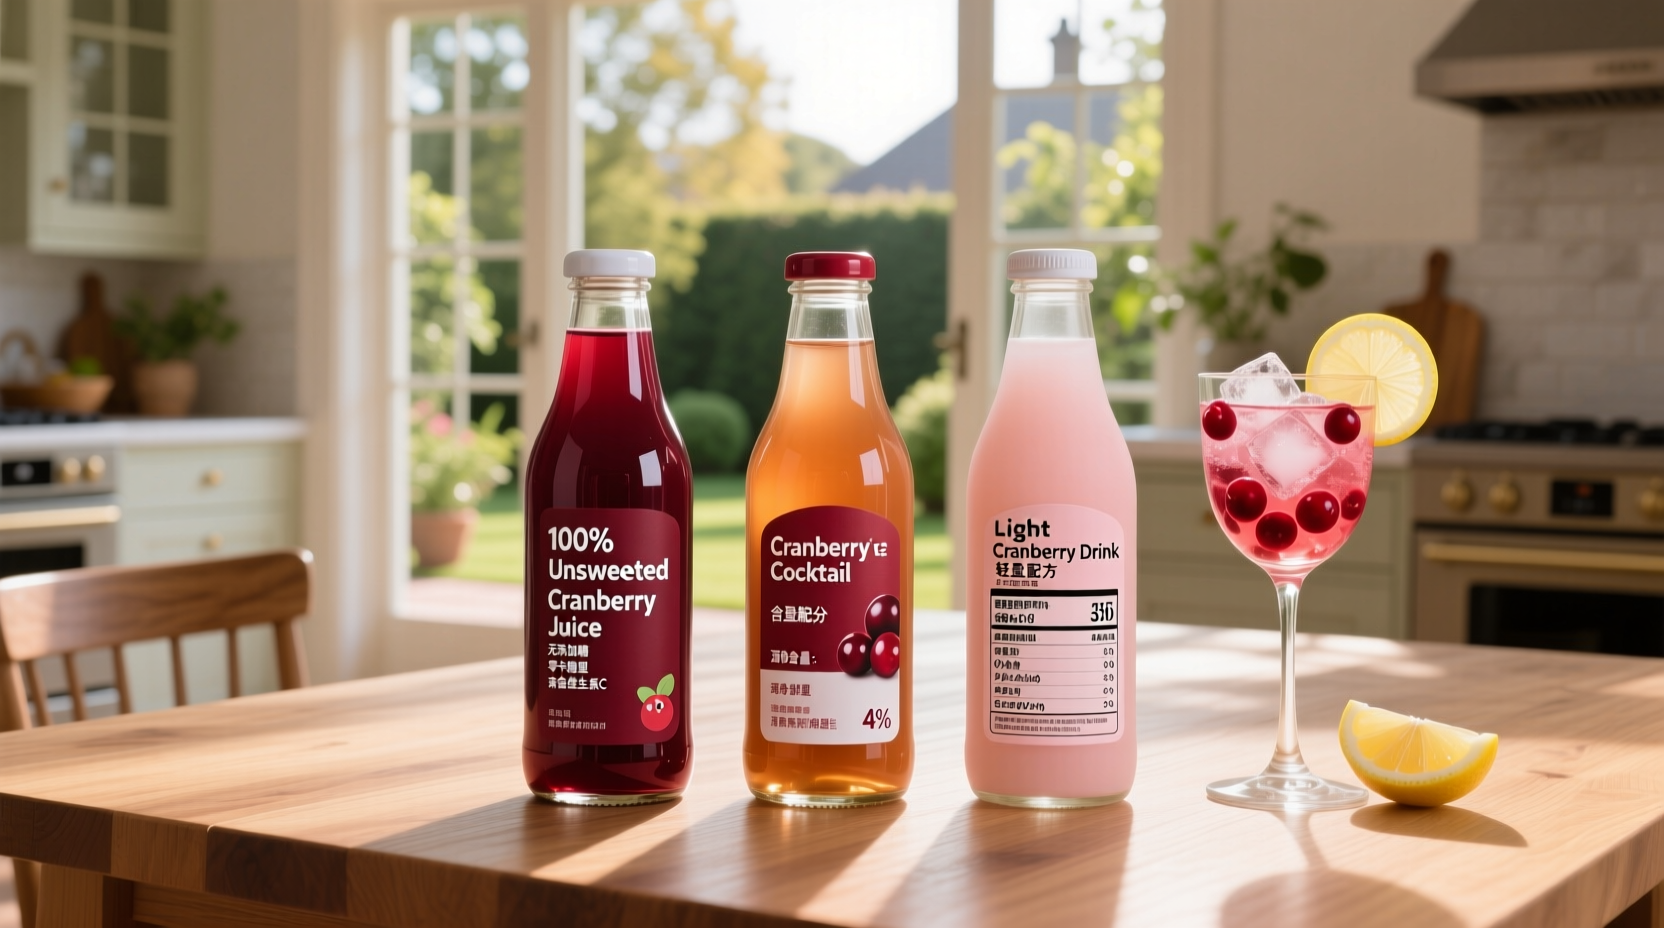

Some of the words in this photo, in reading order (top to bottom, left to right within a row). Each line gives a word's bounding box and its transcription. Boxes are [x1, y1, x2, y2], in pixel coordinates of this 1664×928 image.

[548, 526, 614, 553] 100%
[995, 518, 1050, 542] Light
[993, 542, 1076, 563] Cranberry
[1080, 542, 1120, 560] Drink
[549, 558, 669, 581] Unsweeted
[770, 561, 851, 583] Cocktail
[548, 589, 656, 616] Cranberry
[548, 616, 602, 638] Juice
[862, 708, 892, 729] 4%
